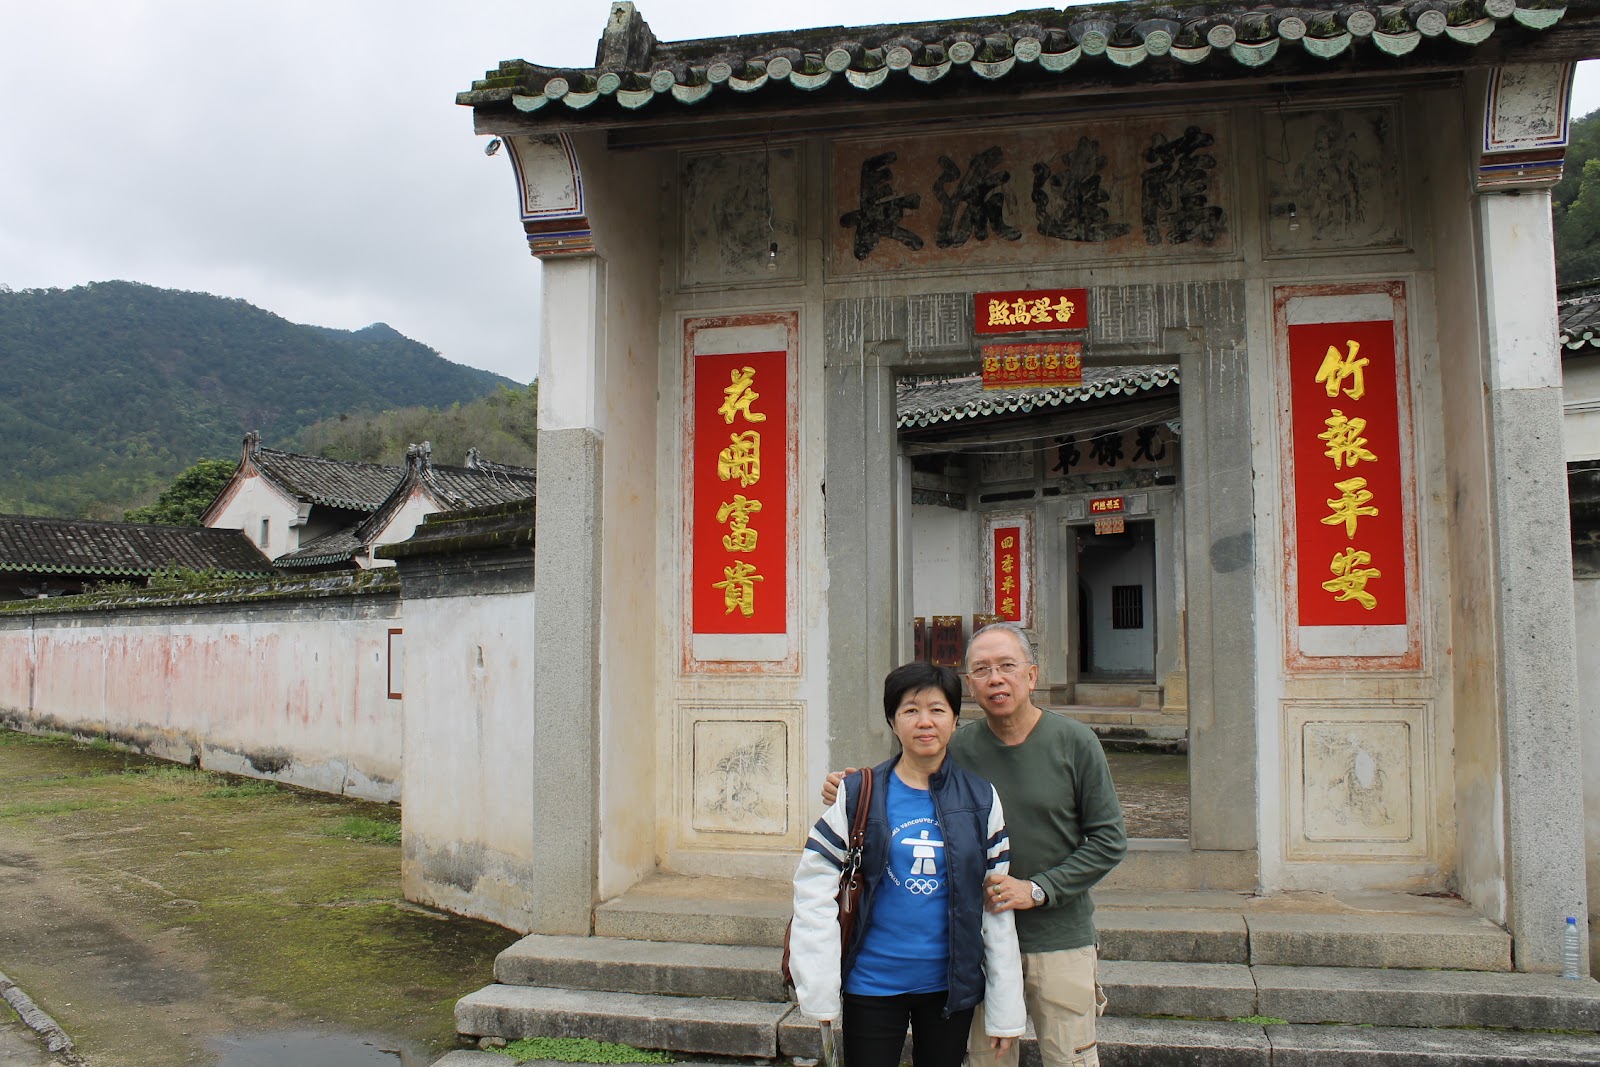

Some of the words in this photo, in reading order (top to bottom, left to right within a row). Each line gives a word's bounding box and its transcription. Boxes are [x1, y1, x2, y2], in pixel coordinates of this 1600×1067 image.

[712, 366, 767, 618] 花開富貴
[1001, 536, 1016, 617] 四季平安
[1315, 339, 1382, 611] 竹報平安
